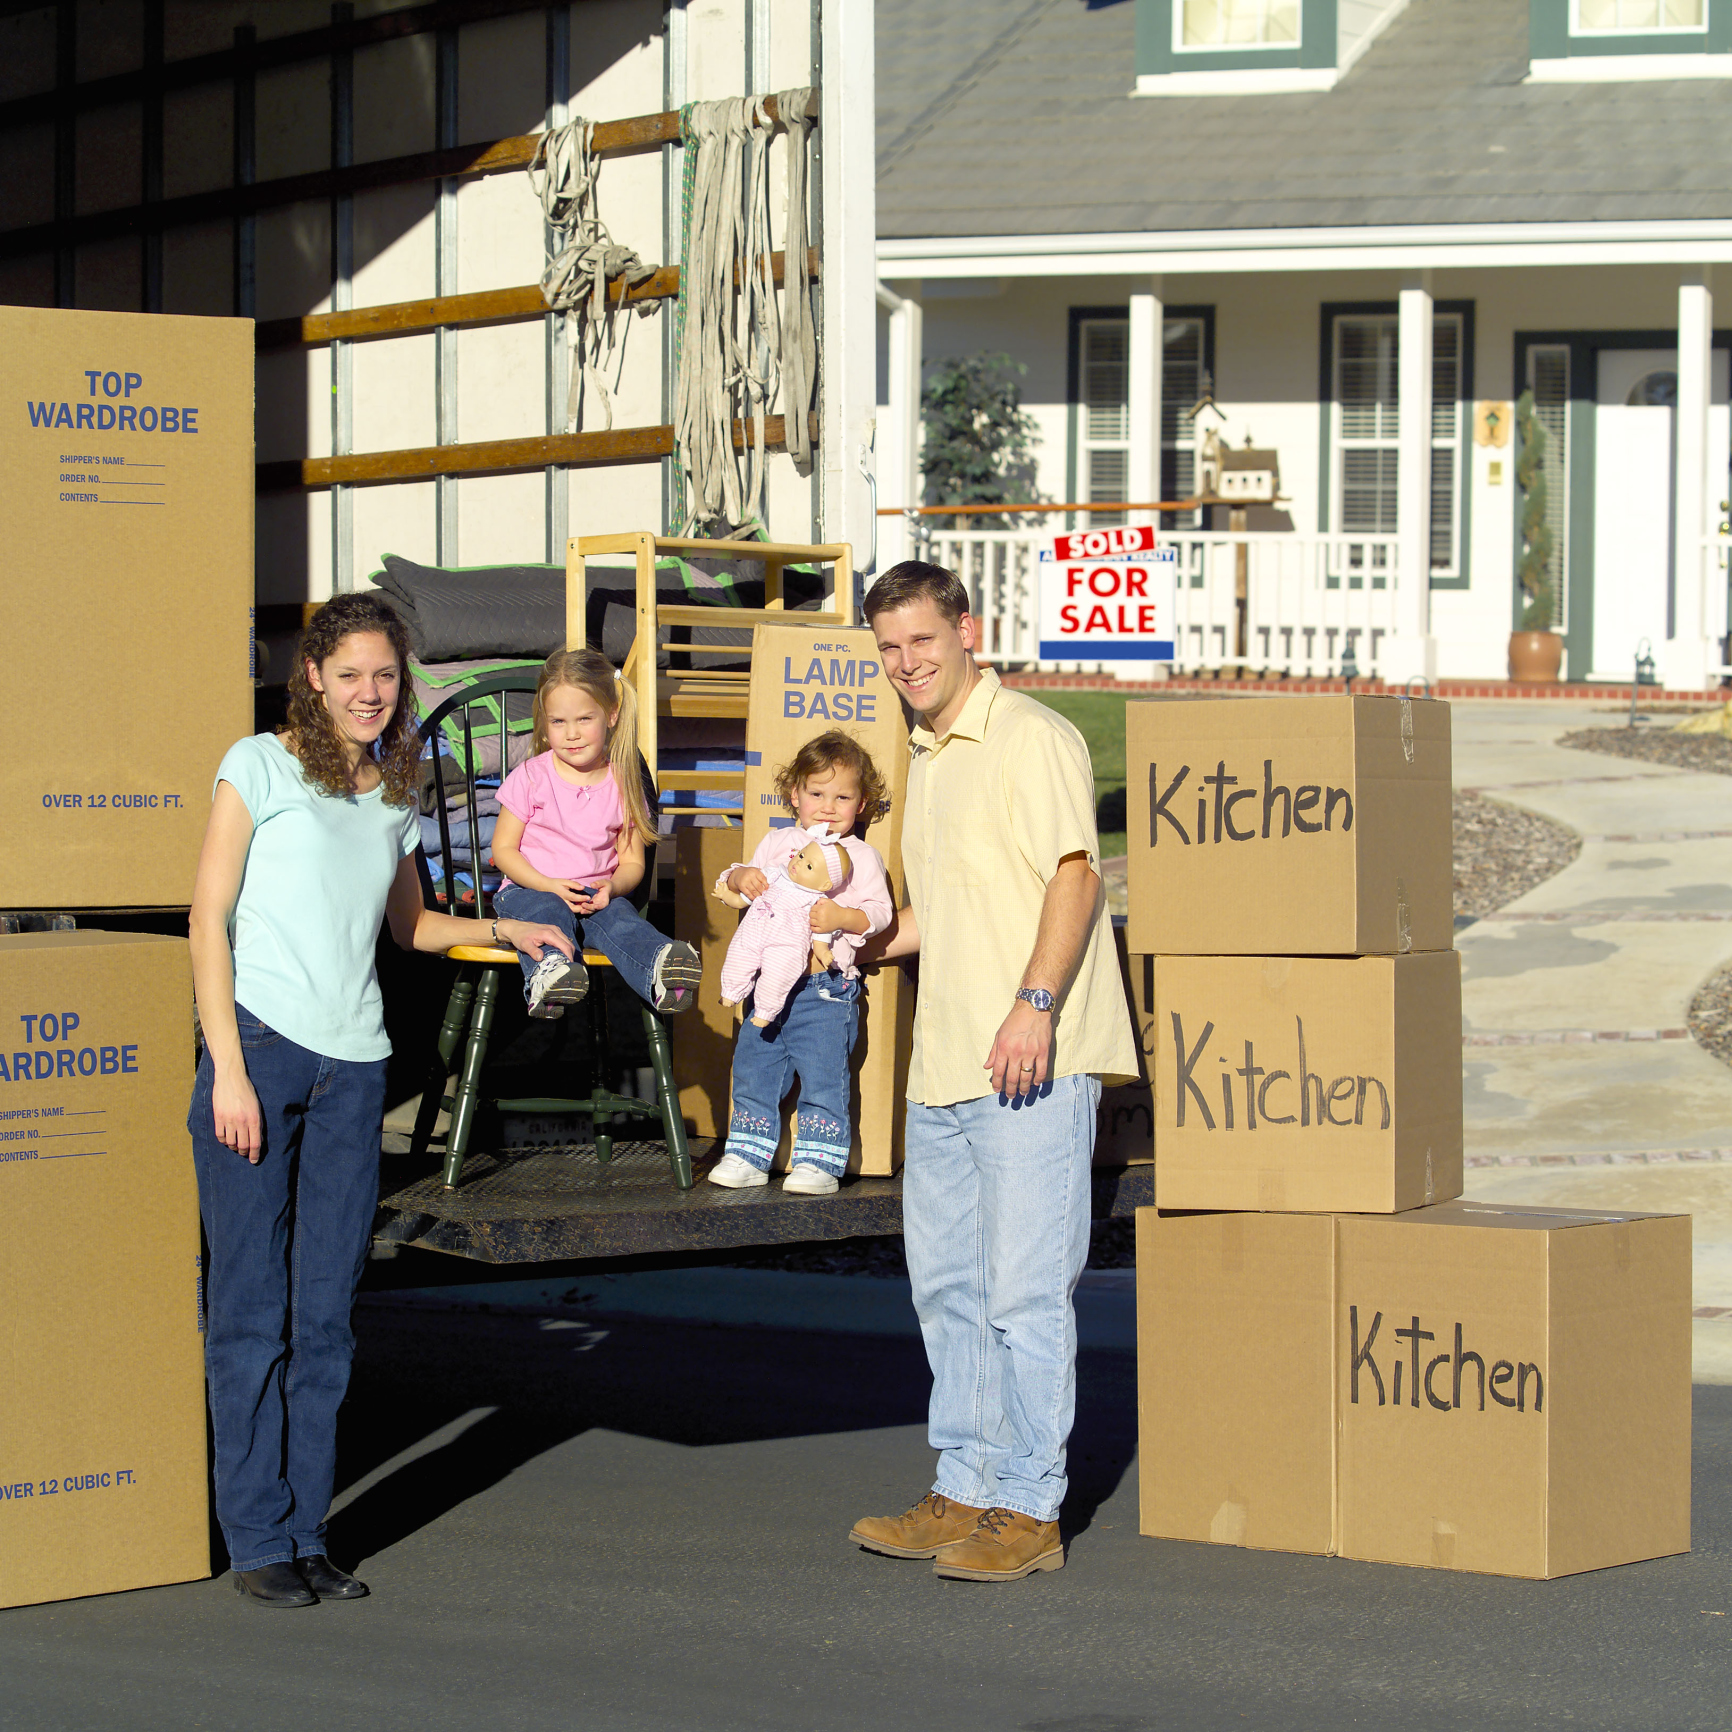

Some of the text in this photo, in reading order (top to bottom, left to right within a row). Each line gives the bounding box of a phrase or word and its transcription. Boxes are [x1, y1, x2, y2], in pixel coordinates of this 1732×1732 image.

[84, 370, 143, 398] TOP
[27, 401, 199, 433] WARDROBE
[59, 455, 125, 466] SHIPPER'S NAME
[59, 474, 101, 484] ORDER NO.
[59, 493, 99, 503] CONTENTS
[1068, 529, 1143, 559] SOLD
[1067, 567, 1148, 598] FOR
[1060, 604, 1156, 634] SALE
[813, 643, 851, 653] ONE PC.
[783, 656, 880, 688] LAMP
[783, 690, 877, 723] BASE
[42, 794, 184, 808] OVER 12 CUBIC FT.
[1149, 759, 1354, 848] Kitchen
[20, 1012, 80, 1043] TOP
[0, 1044, 139, 1082] ARDROBE
[1170, 1010, 1391, 1132] Kitchen
[41, 1106, 65, 1117] NAME
[27, 1129, 41, 1139] NO.
[0, 1150, 39, 1162] CONTENTS
[196, 1275, 204, 1333] WARDROBE
[1350, 1305, 1544, 1412] Kitchen
[39, 1479, 59, 1495] 12
[63, 1472, 111, 1492] CUBIC
[116, 1469, 137, 1486] FT.
